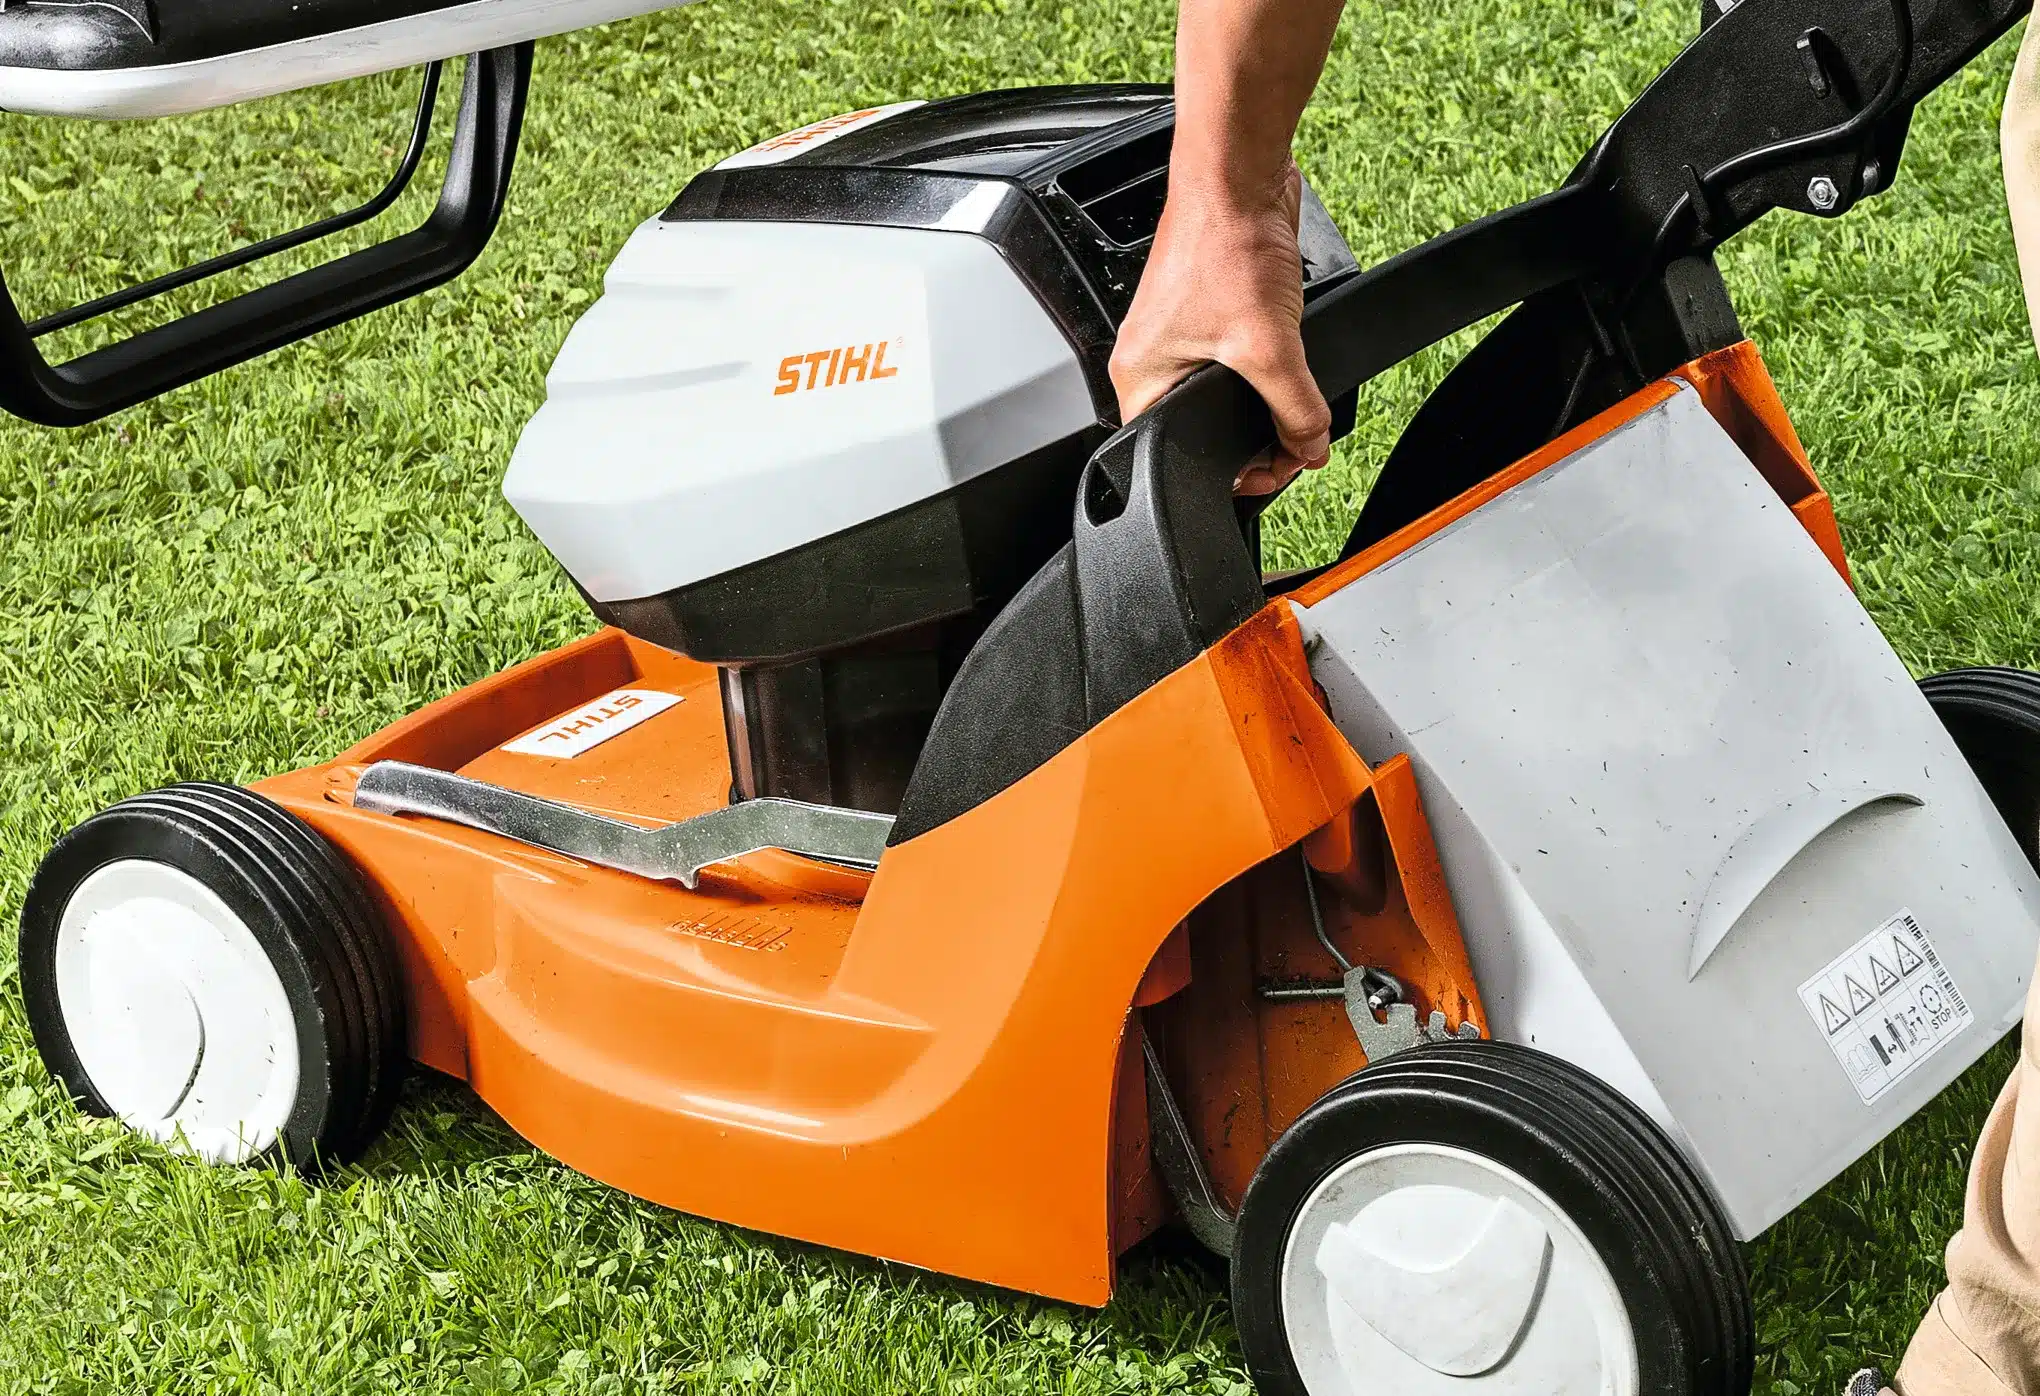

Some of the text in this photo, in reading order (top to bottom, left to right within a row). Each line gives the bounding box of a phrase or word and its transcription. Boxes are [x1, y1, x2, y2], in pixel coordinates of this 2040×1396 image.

[774, 341, 898, 395] STIHL
[538, 695, 643, 742] STIHL
[1931, 1008, 1952, 1030] STOP
